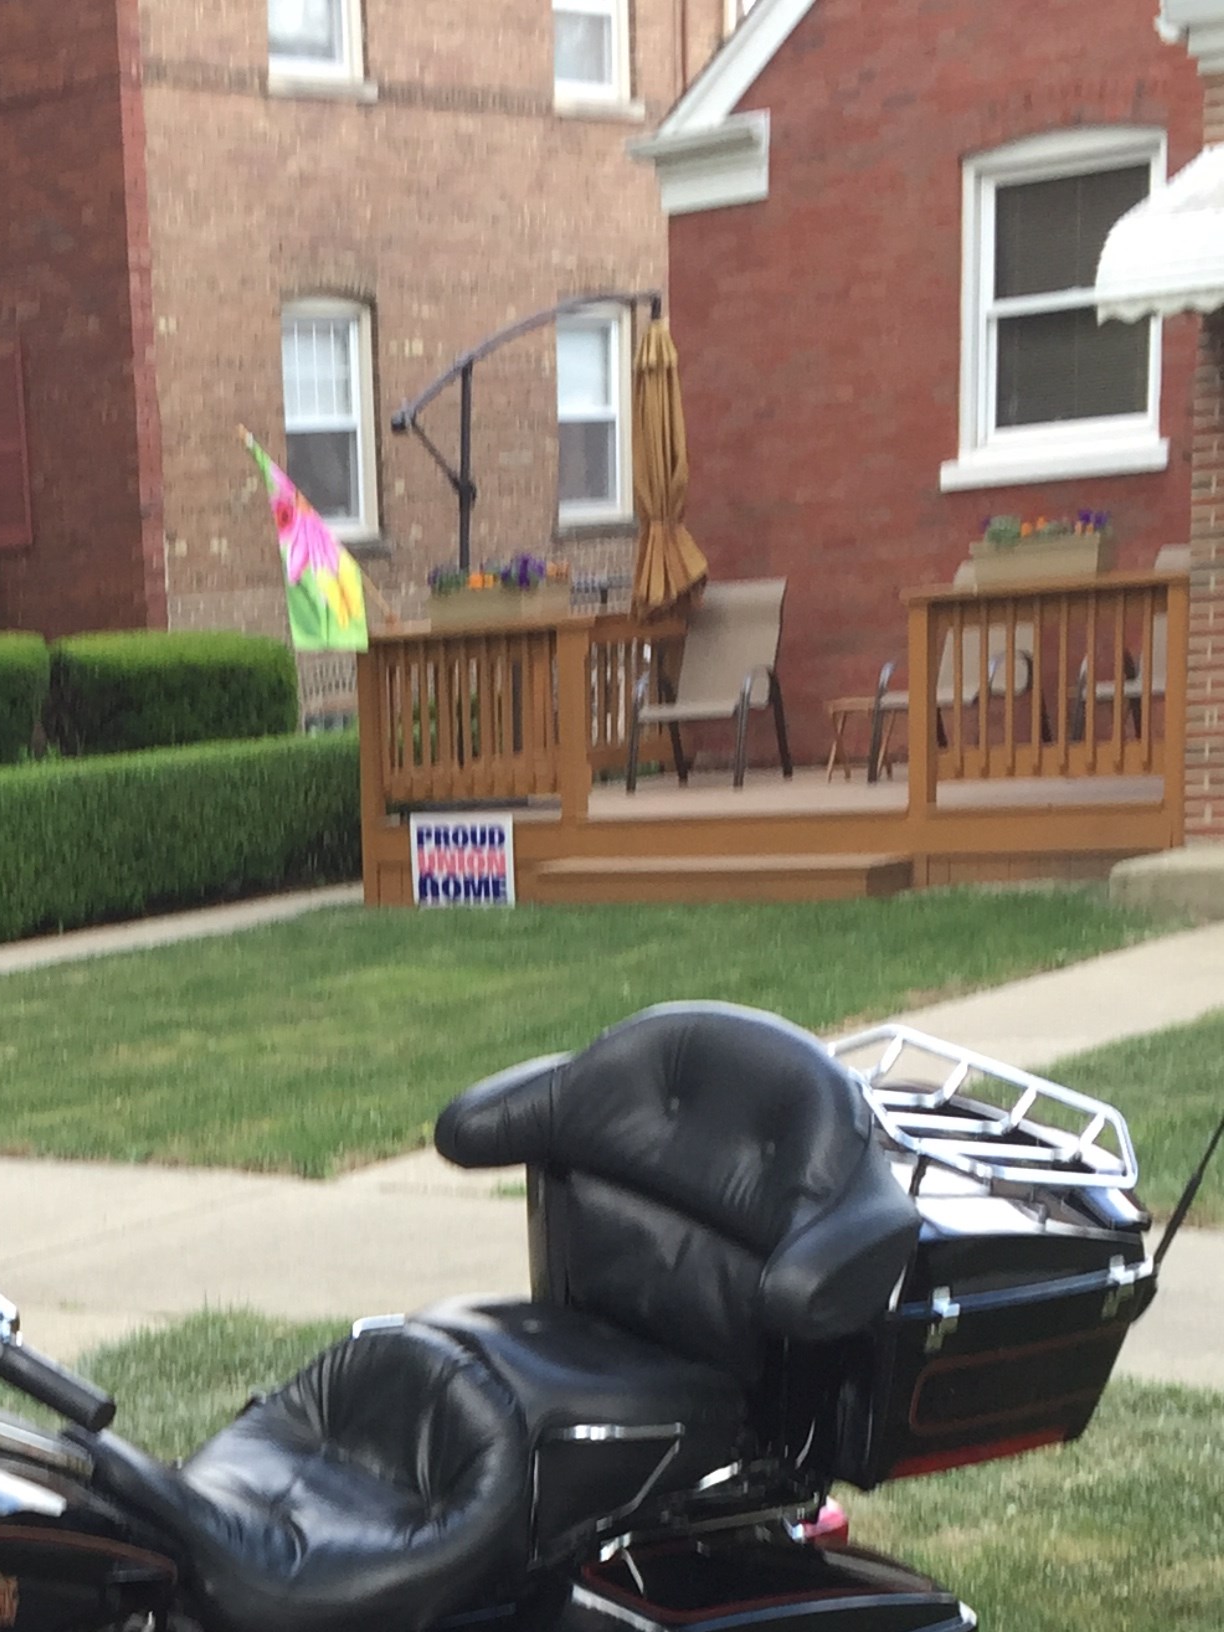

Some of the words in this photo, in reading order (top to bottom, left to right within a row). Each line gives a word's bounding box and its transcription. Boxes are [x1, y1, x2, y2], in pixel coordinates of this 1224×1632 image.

[417, 826, 505, 847] PROUD
[417, 848, 506, 876] UNION
[418, 875, 508, 904] HOME
